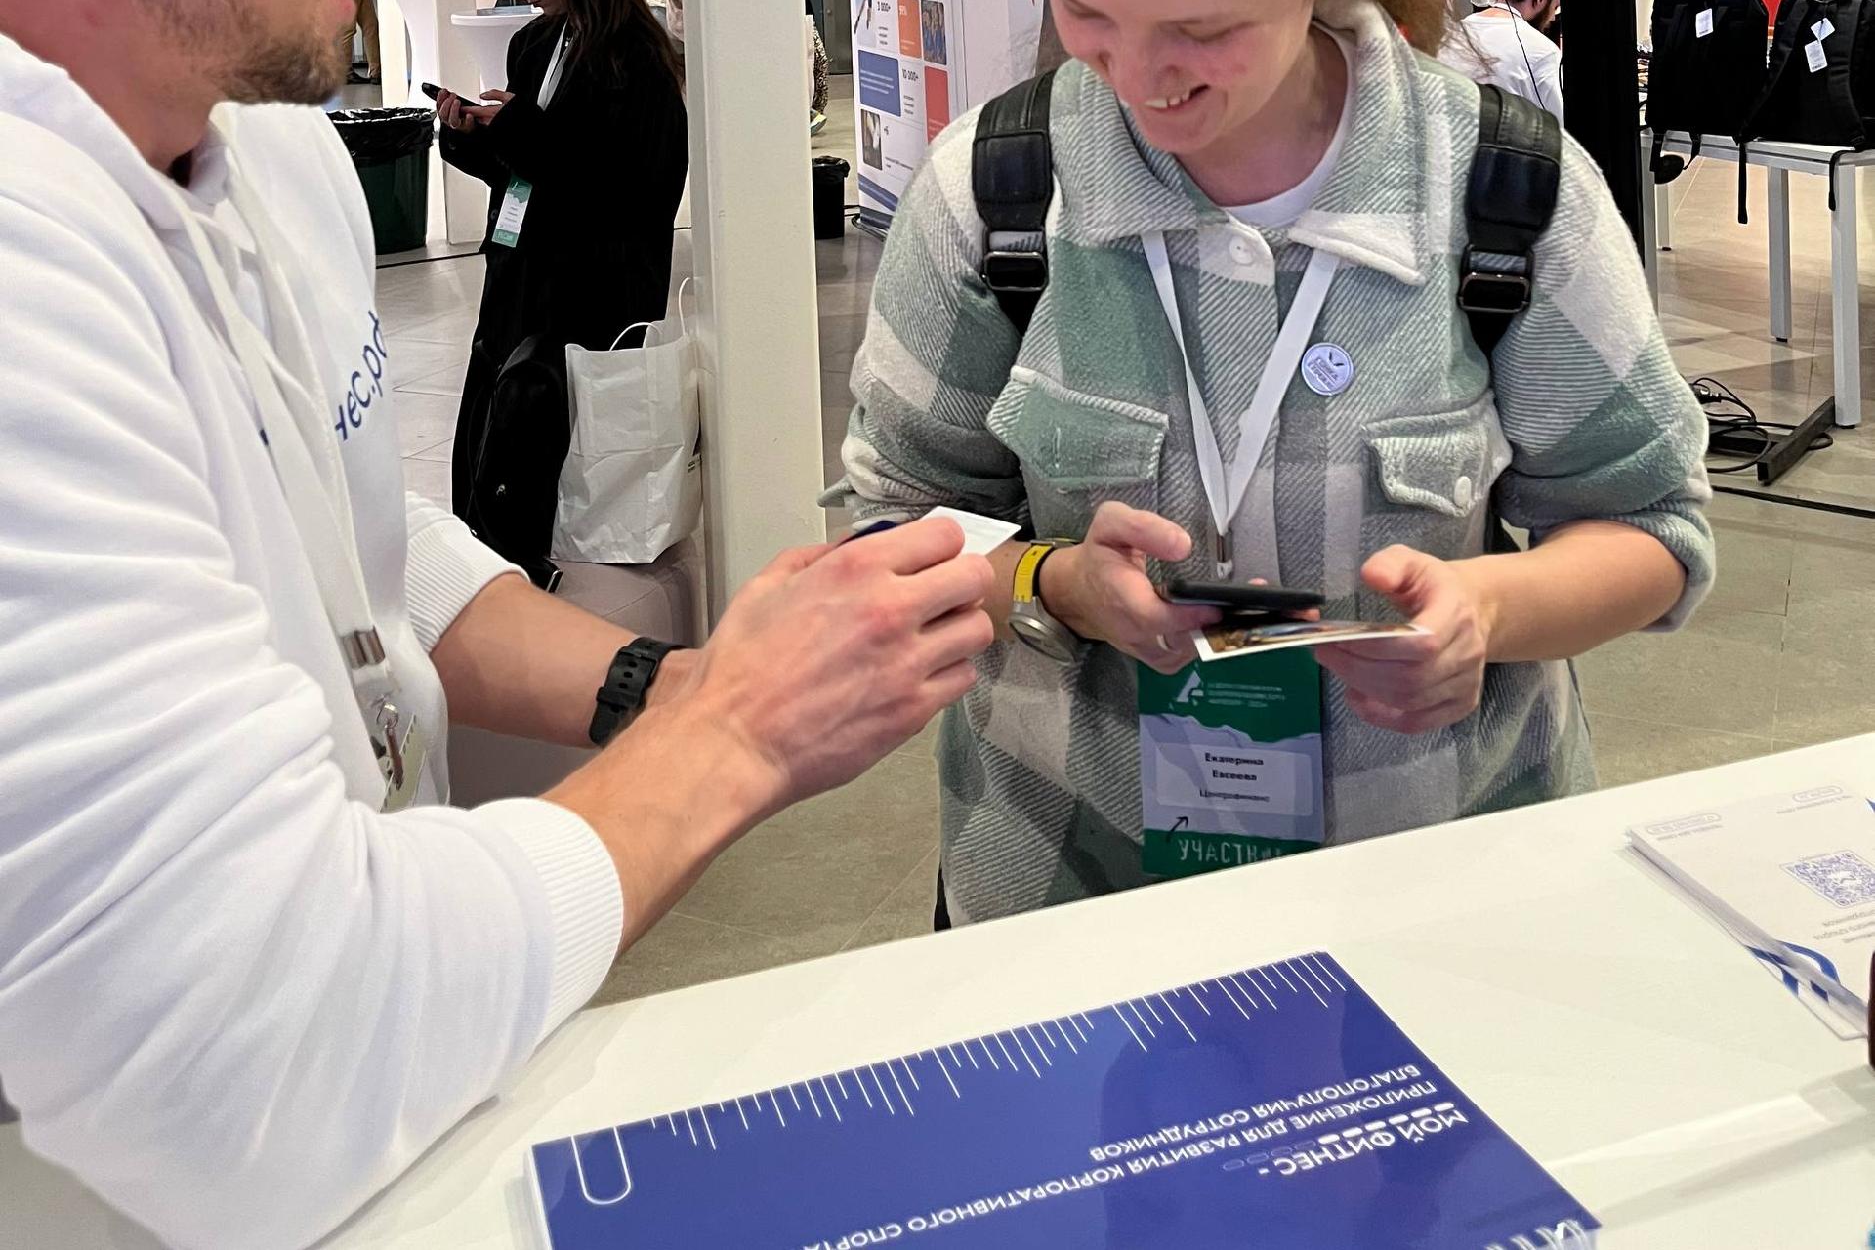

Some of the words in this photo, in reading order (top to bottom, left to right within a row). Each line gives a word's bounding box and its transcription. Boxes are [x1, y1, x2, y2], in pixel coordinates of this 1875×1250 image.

[1250, 1063, 1422, 1118] БЛАГОПОЛУЧИЯ
[1289, 1080, 1438, 1126] ПРИЛОЖЕНИЕ
[1090, 1110, 1248, 1163] СОТРУДНИКОВ
[1241, 1117, 1288, 1143] ДЛЯ
[1396, 1109, 1469, 1143] МОЙ
[1126, 1133, 1240, 1173] РАЗВИТИЯ
[1274, 1129, 1397, 1176] ФИТНЕС
[908, 1157, 1125, 1237] КОРПОРАТИВНОГО
